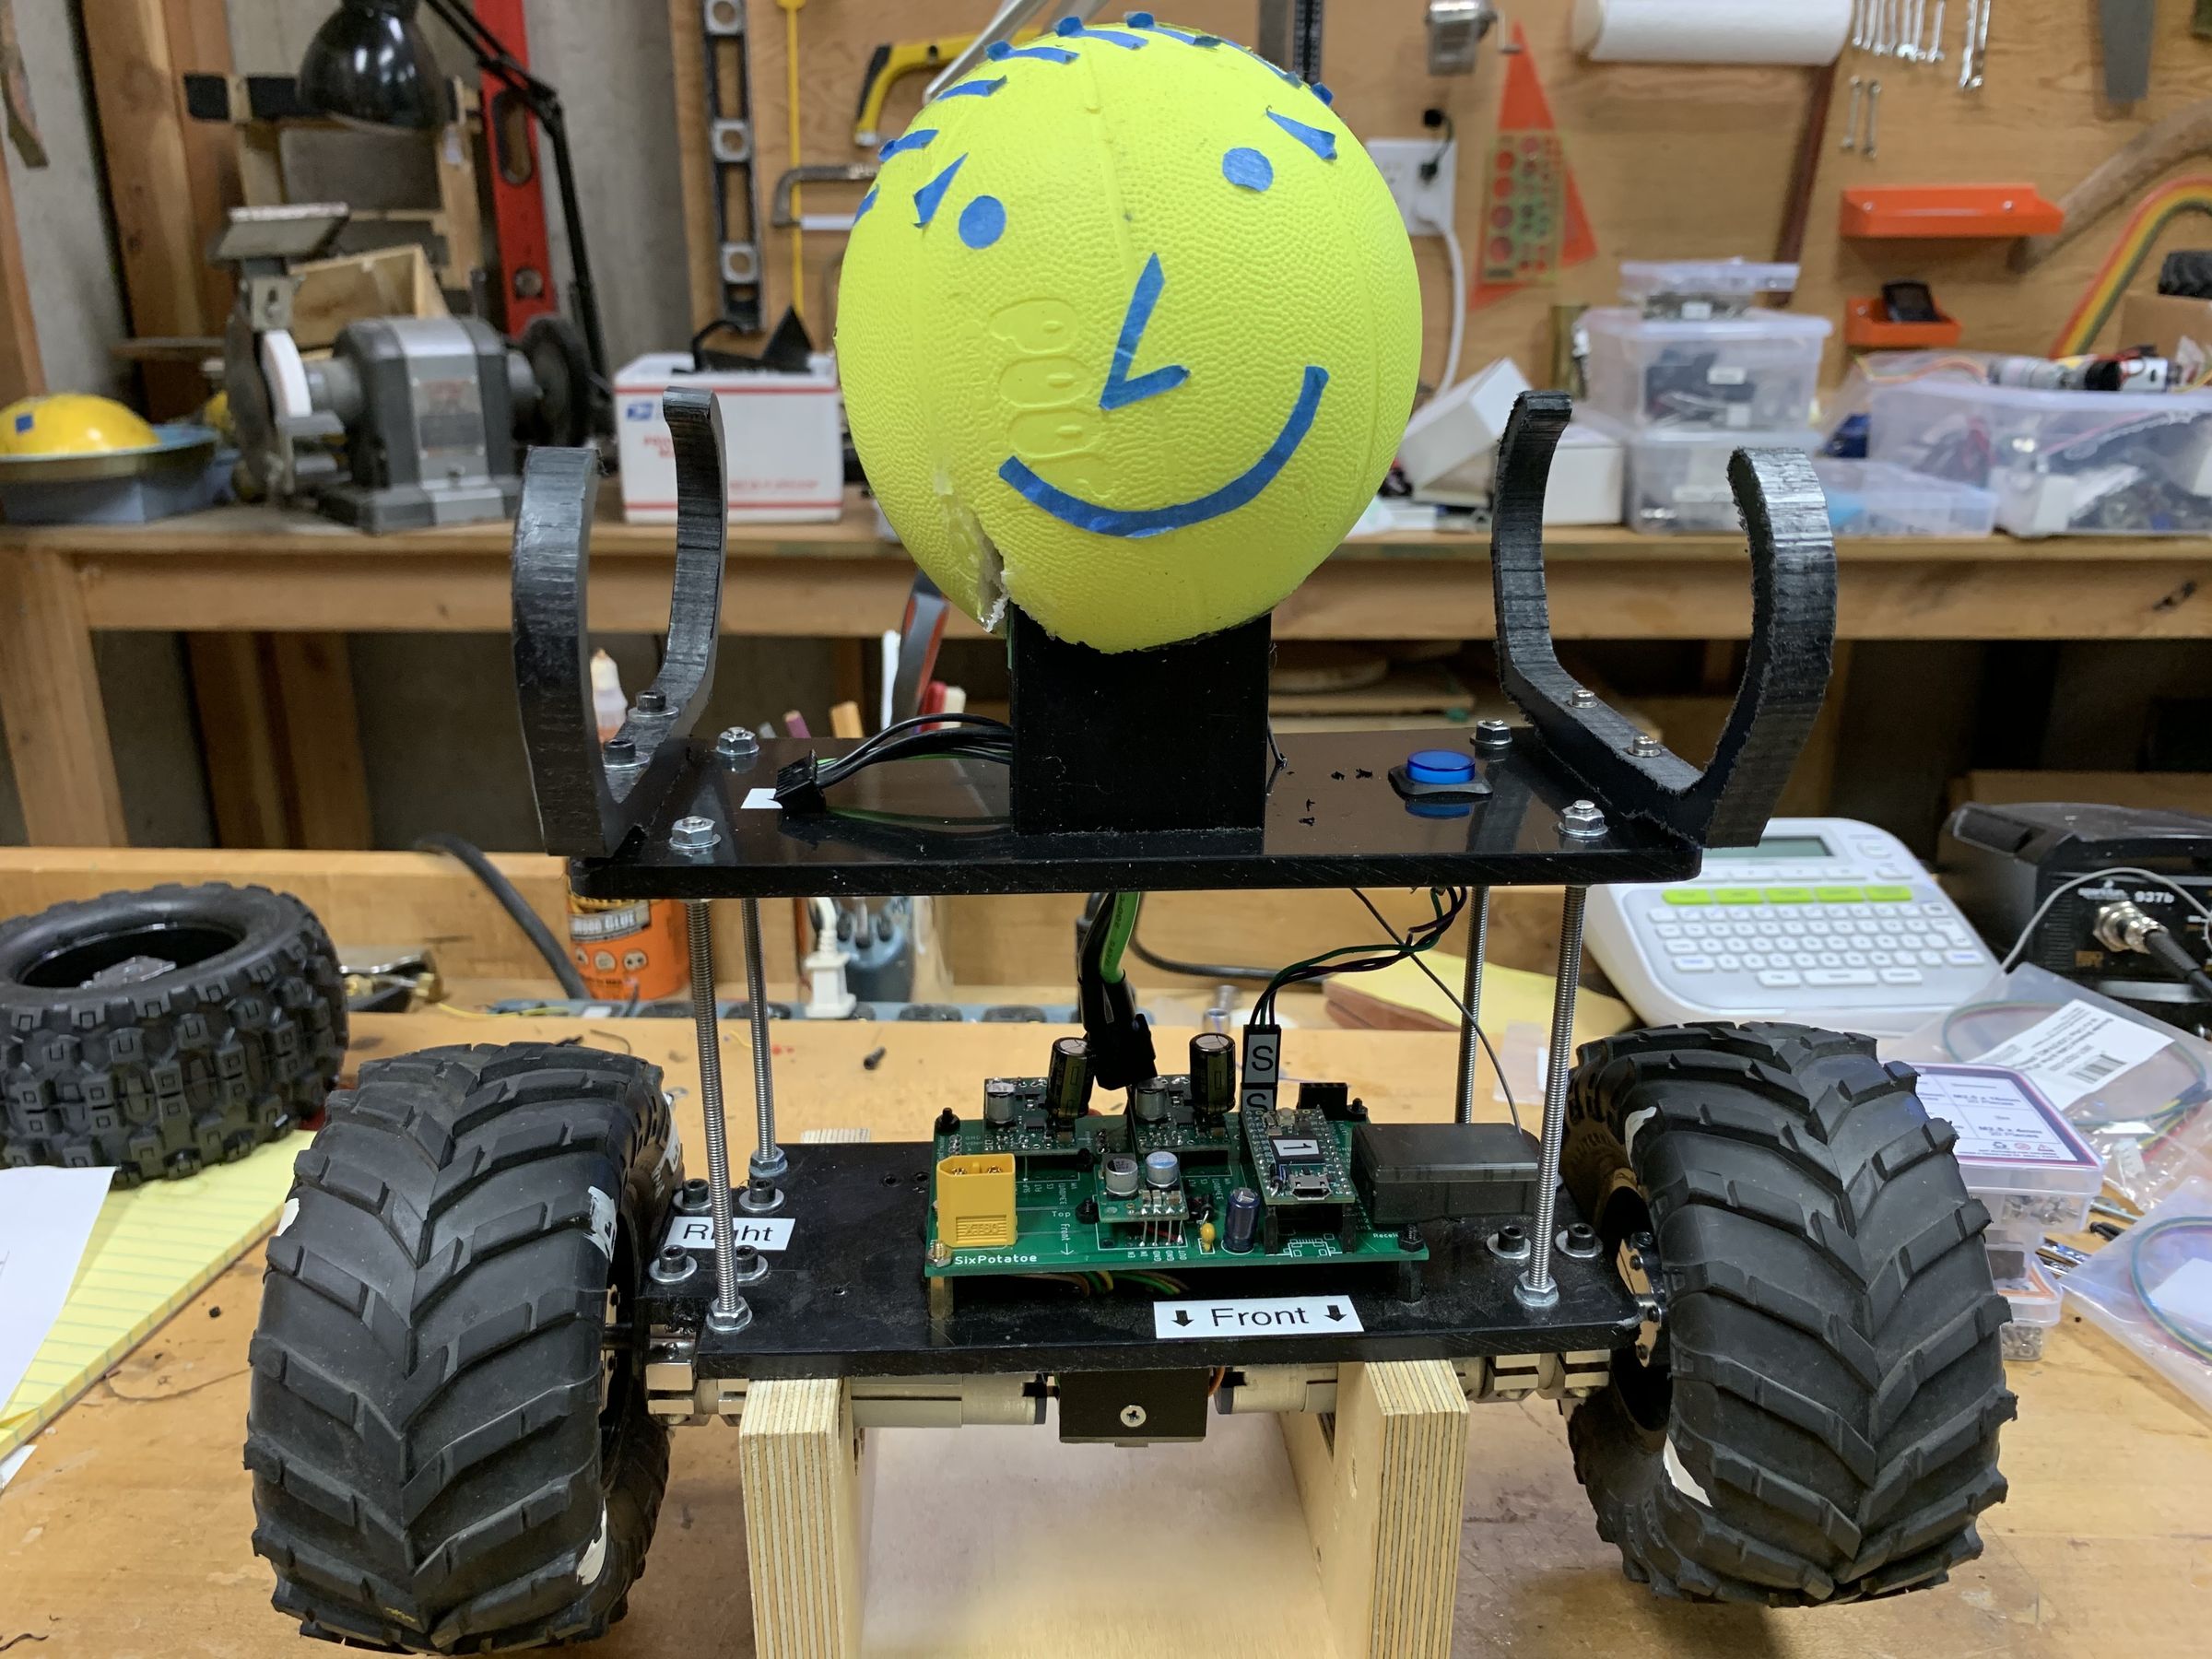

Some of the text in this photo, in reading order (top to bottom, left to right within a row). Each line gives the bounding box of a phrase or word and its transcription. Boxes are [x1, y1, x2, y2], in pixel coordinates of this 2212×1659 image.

[1252, 1045, 1274, 1071] S
[1283, 1142, 1312, 1150] 1
[683, 1223, 774, 1241] Rht
[954, 1253, 1038, 1265] SixPotatoe
[1210, 1307, 1310, 1327] Front
